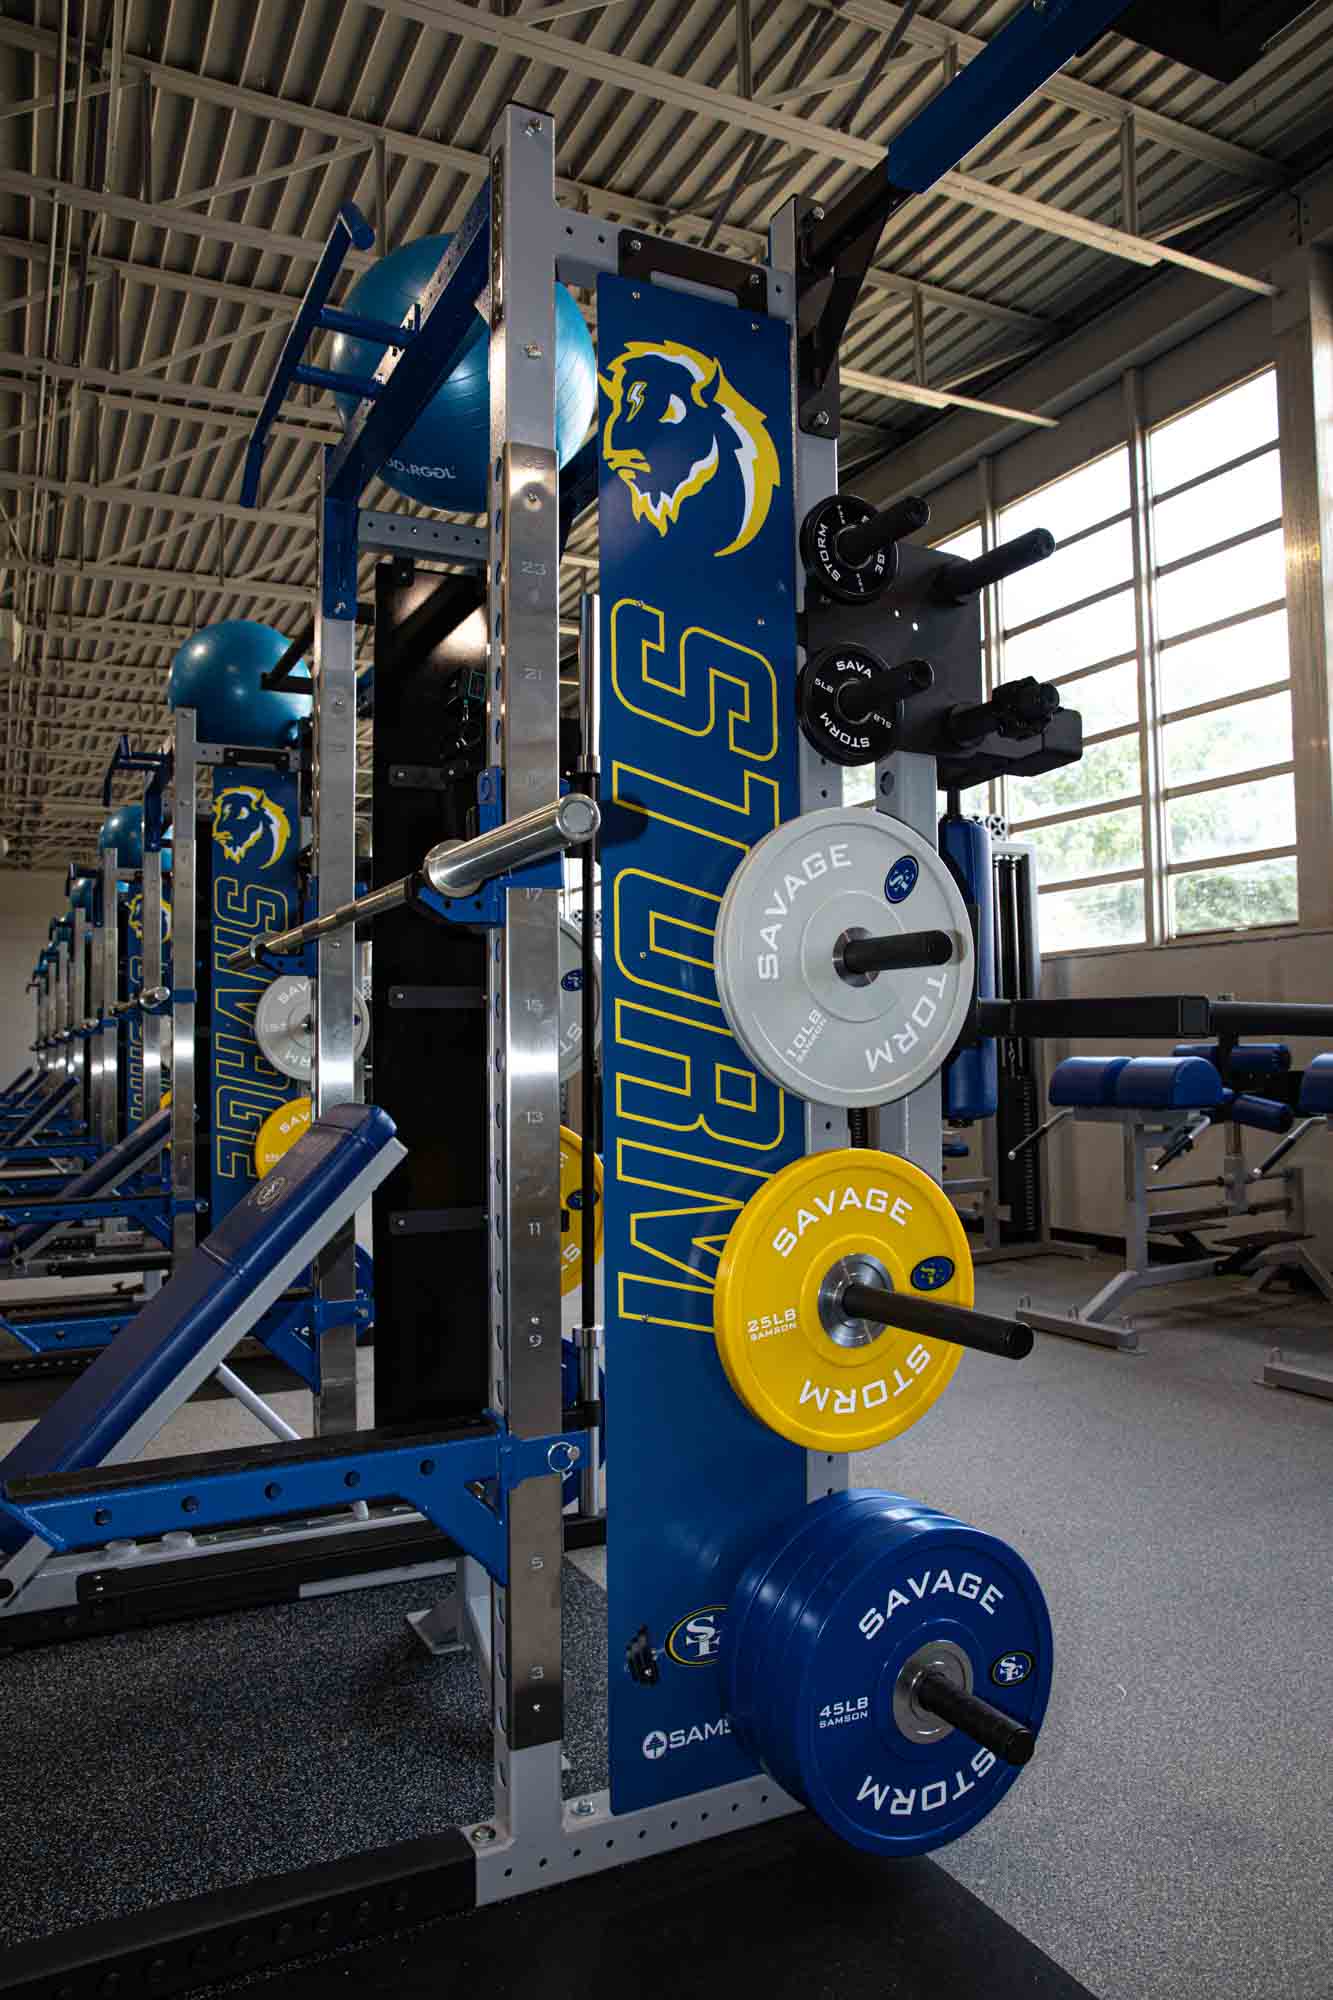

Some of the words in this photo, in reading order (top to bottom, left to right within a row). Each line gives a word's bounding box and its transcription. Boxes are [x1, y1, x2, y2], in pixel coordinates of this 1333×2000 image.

[520, 560, 546, 576] 23
[817, 522, 841, 582] STORM
[814, 677, 834, 694] 5LB
[836, 659, 873, 679] SAVA
[819, 711, 871, 749] STORM
[757, 843, 853, 981] SAVAGE
[610, 598, 785, 1334] STORM
[786, 1008, 823, 1058] 10LB
[864, 970, 949, 1074] TORM
[528, 1222, 541, 1236] 11
[772, 1187, 913, 1257] SAVAGE
[747, 1308, 797, 1334] 25LB
[799, 1343, 932, 1415] STORM
[858, 1569, 1004, 1640] SAVAGE
[819, 1696, 869, 1719] 45LB
[819, 1710, 869, 1729] SAMSON
[668, 1717, 732, 1750] SAM
[856, 1746, 998, 1816] STORM
